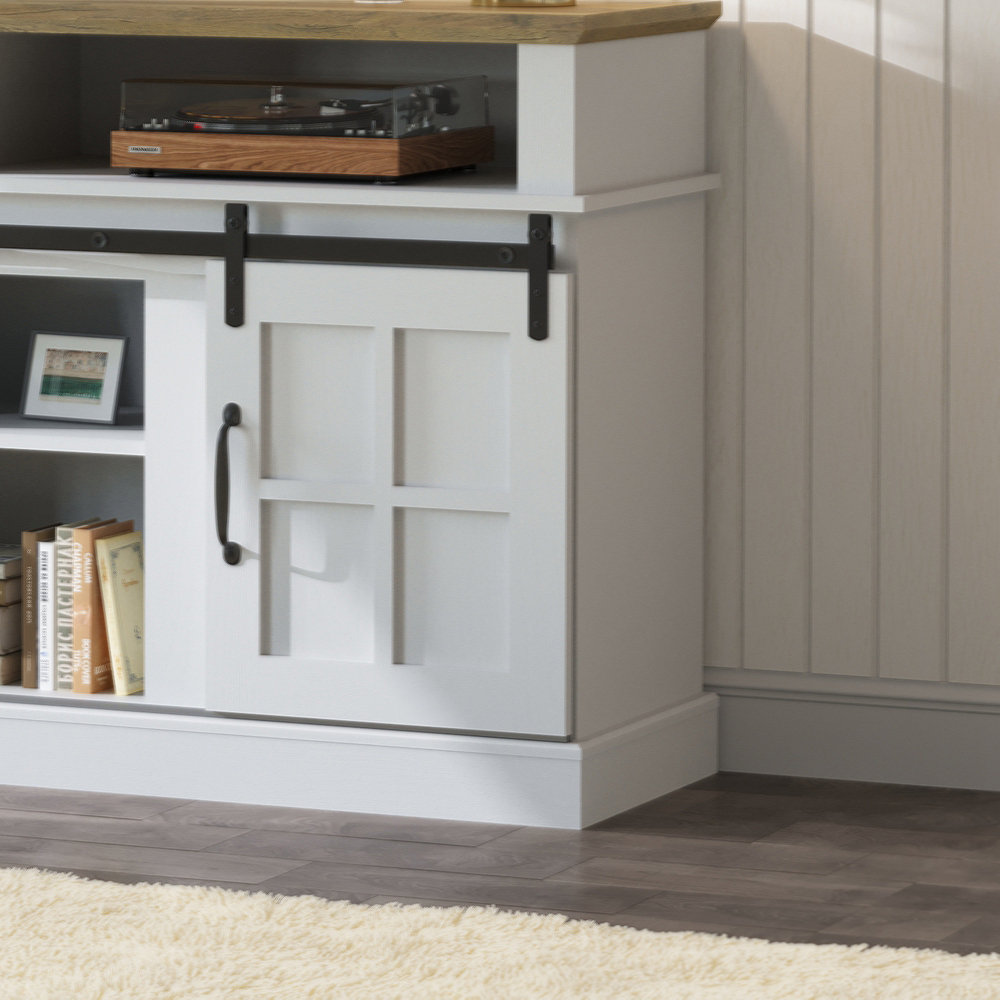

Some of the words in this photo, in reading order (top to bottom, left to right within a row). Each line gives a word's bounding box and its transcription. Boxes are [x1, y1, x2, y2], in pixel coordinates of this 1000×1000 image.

[57, 535, 73, 628] ПАСТЕРНАК
[72, 542, 82, 593] CHAPMAN
[84, 552, 94, 584] CALLUM
[57, 631, 73, 682] БОРИС
[81, 639, 91, 660] BOOK
[81, 660, 91, 685] COVER
